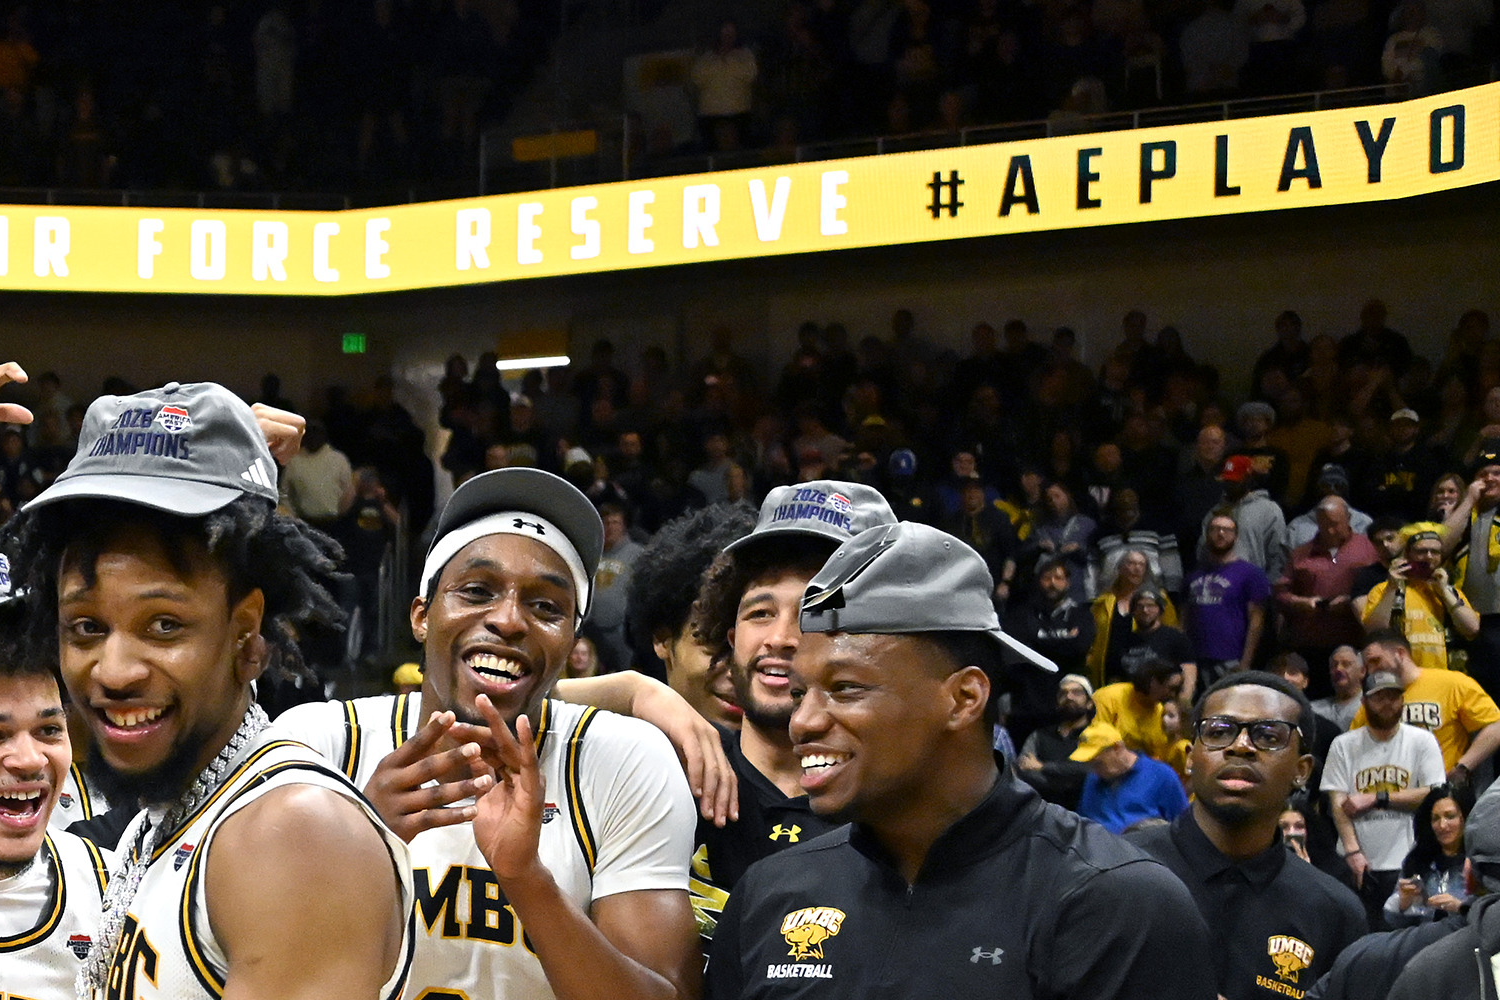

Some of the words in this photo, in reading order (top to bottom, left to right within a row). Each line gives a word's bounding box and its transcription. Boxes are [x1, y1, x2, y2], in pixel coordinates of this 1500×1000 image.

[927, 103, 1466, 219] #AEPLAYO
[137, 216, 392, 283] FORCE
[455, 169, 849, 271] RESERVE
[112, 408, 152, 429] 2026
[157, 413, 191, 424] AMERICA
[89, 432, 189, 460] CHAMPIONS
[792, 488, 827, 504] 2026
[772, 503, 851, 531] CHAMPIONS
[1356, 765, 1410, 792] UMBC
[781, 907, 847, 936] UMBC
[1268, 935, 1315, 968] UMBC
[767, 964, 833, 978] BASKETBALL
